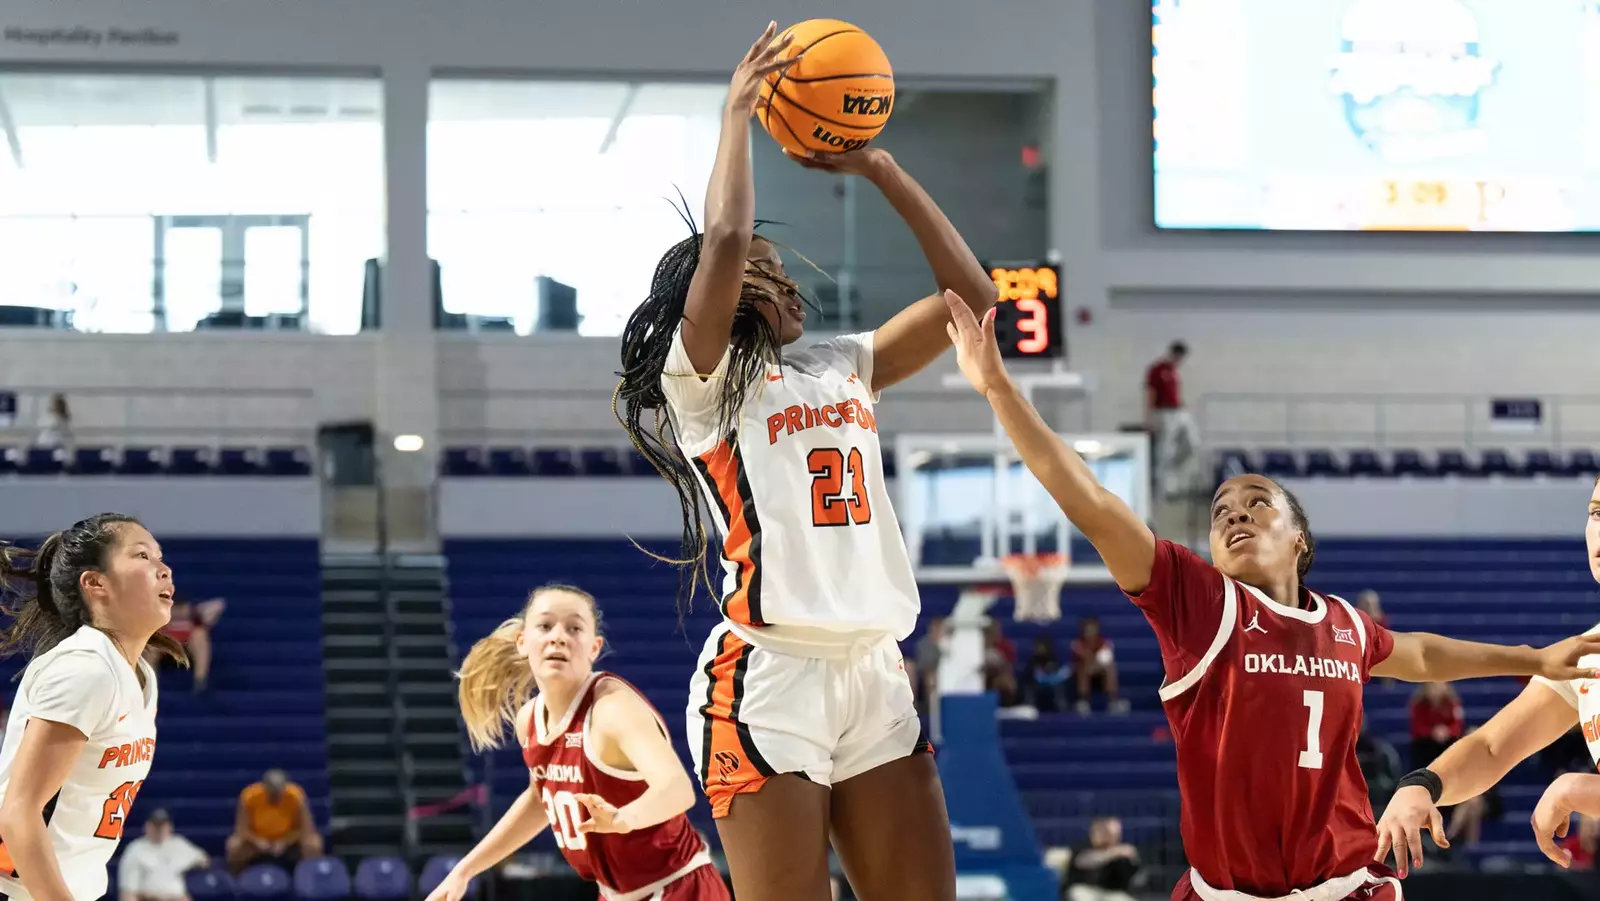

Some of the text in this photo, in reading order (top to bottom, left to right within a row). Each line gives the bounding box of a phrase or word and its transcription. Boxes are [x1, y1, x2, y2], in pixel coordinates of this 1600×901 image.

[842, 93, 893, 115] NCAA
[1015, 299, 1048, 353] 3
[806, 447, 871, 527] 23
[1244, 653, 1361, 684] OKLAHOMA
[1298, 689, 1324, 769] 1
[542, 786, 587, 851] 20
